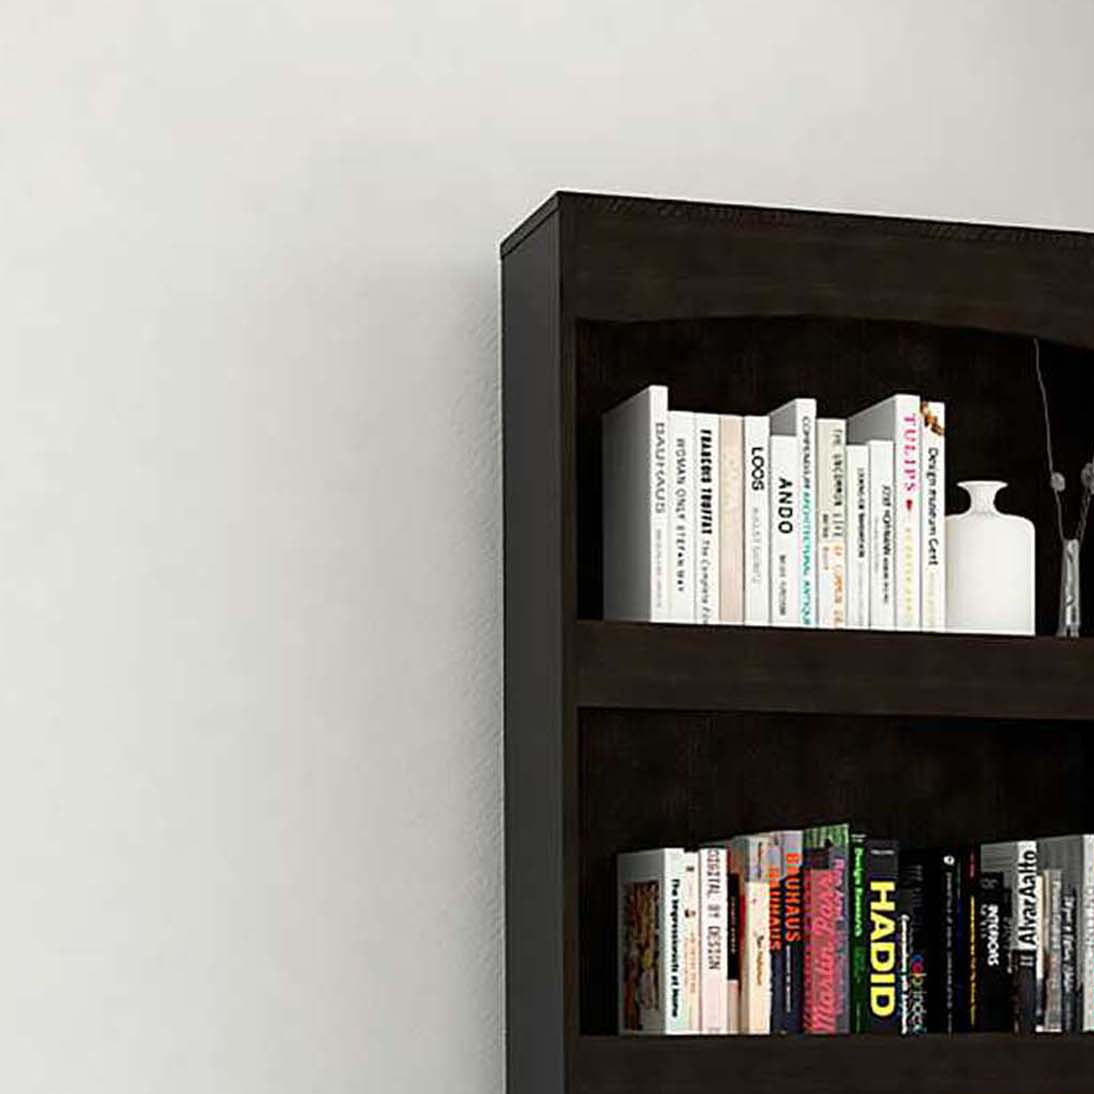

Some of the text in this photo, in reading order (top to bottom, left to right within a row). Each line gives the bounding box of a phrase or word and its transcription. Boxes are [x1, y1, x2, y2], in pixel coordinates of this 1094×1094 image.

[654, 422, 667, 515] BAUHAUS
[675, 437, 687, 486] WOMAN
[751, 446, 765, 492] LOOS
[903, 412, 918, 493] TULIPS
[926, 447, 939, 488] Design
[778, 476, 793, 535] ANDO
[927, 489, 939, 538] museum
[671, 878, 682, 897] The
[707, 848, 722, 900] DIGITAL
[784, 851, 802, 943] BAUHAUS
[707, 926, 722, 971] DESIGN
[869, 880, 897, 1018] HADID
